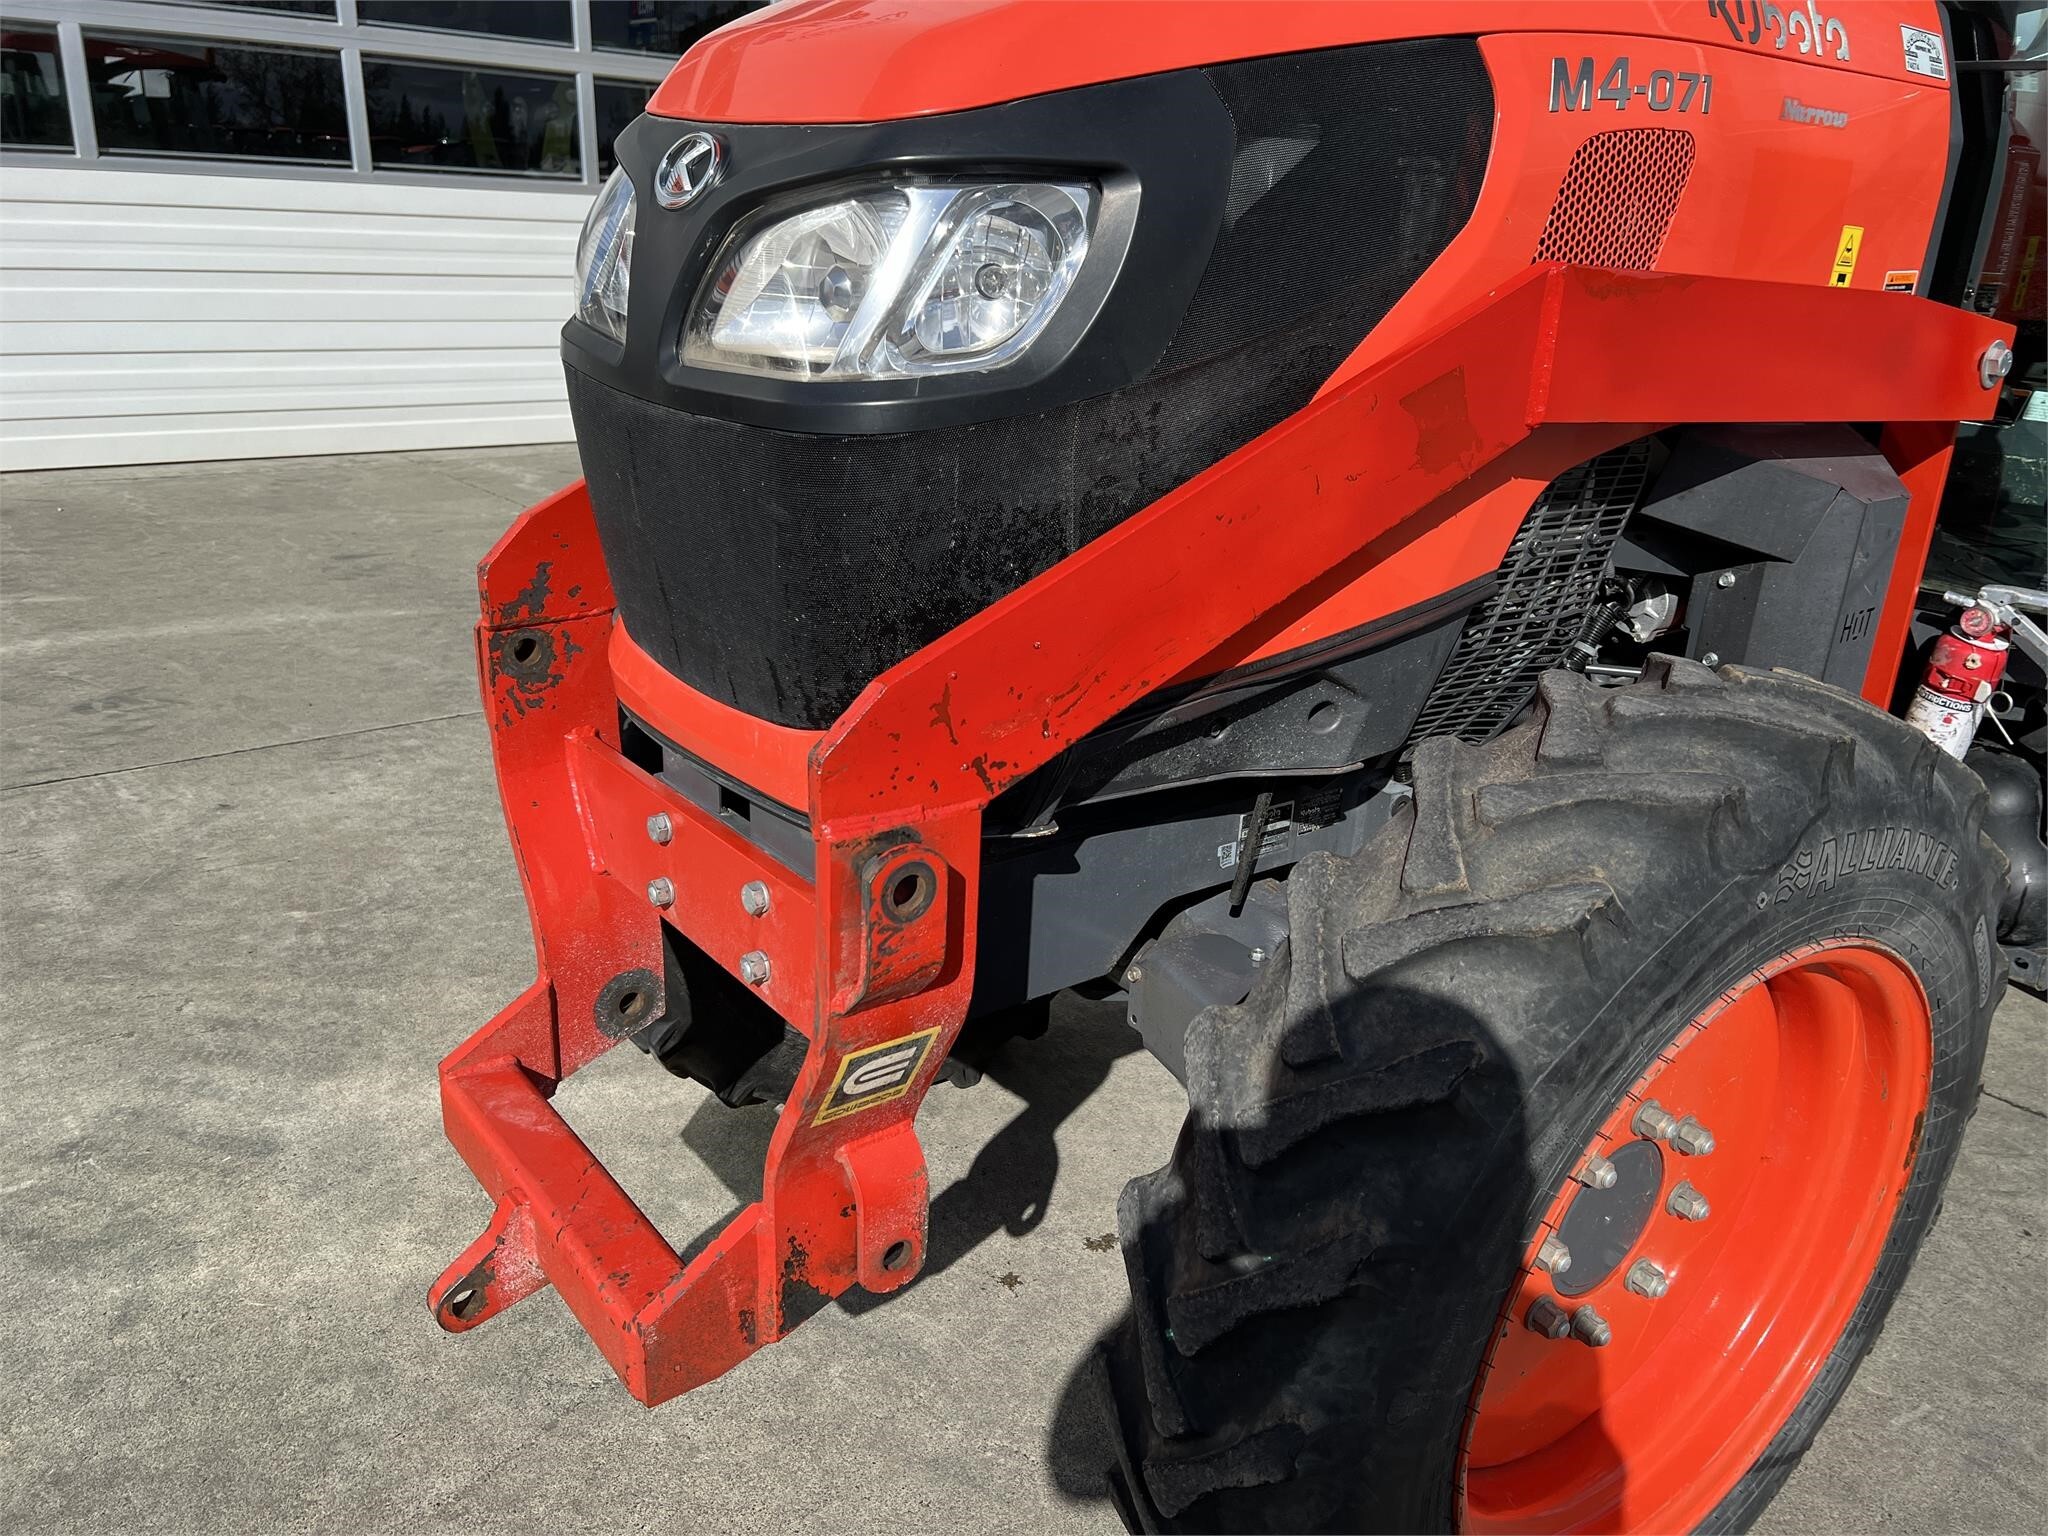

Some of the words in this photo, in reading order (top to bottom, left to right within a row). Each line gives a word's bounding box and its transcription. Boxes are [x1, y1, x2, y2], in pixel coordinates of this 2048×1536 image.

[1549, 56, 1713, 114] M4-071
[1780, 97, 1849, 128] Narrow
[1839, 606, 1875, 644] HOT
[1807, 827, 1959, 899] ALLIANCE
